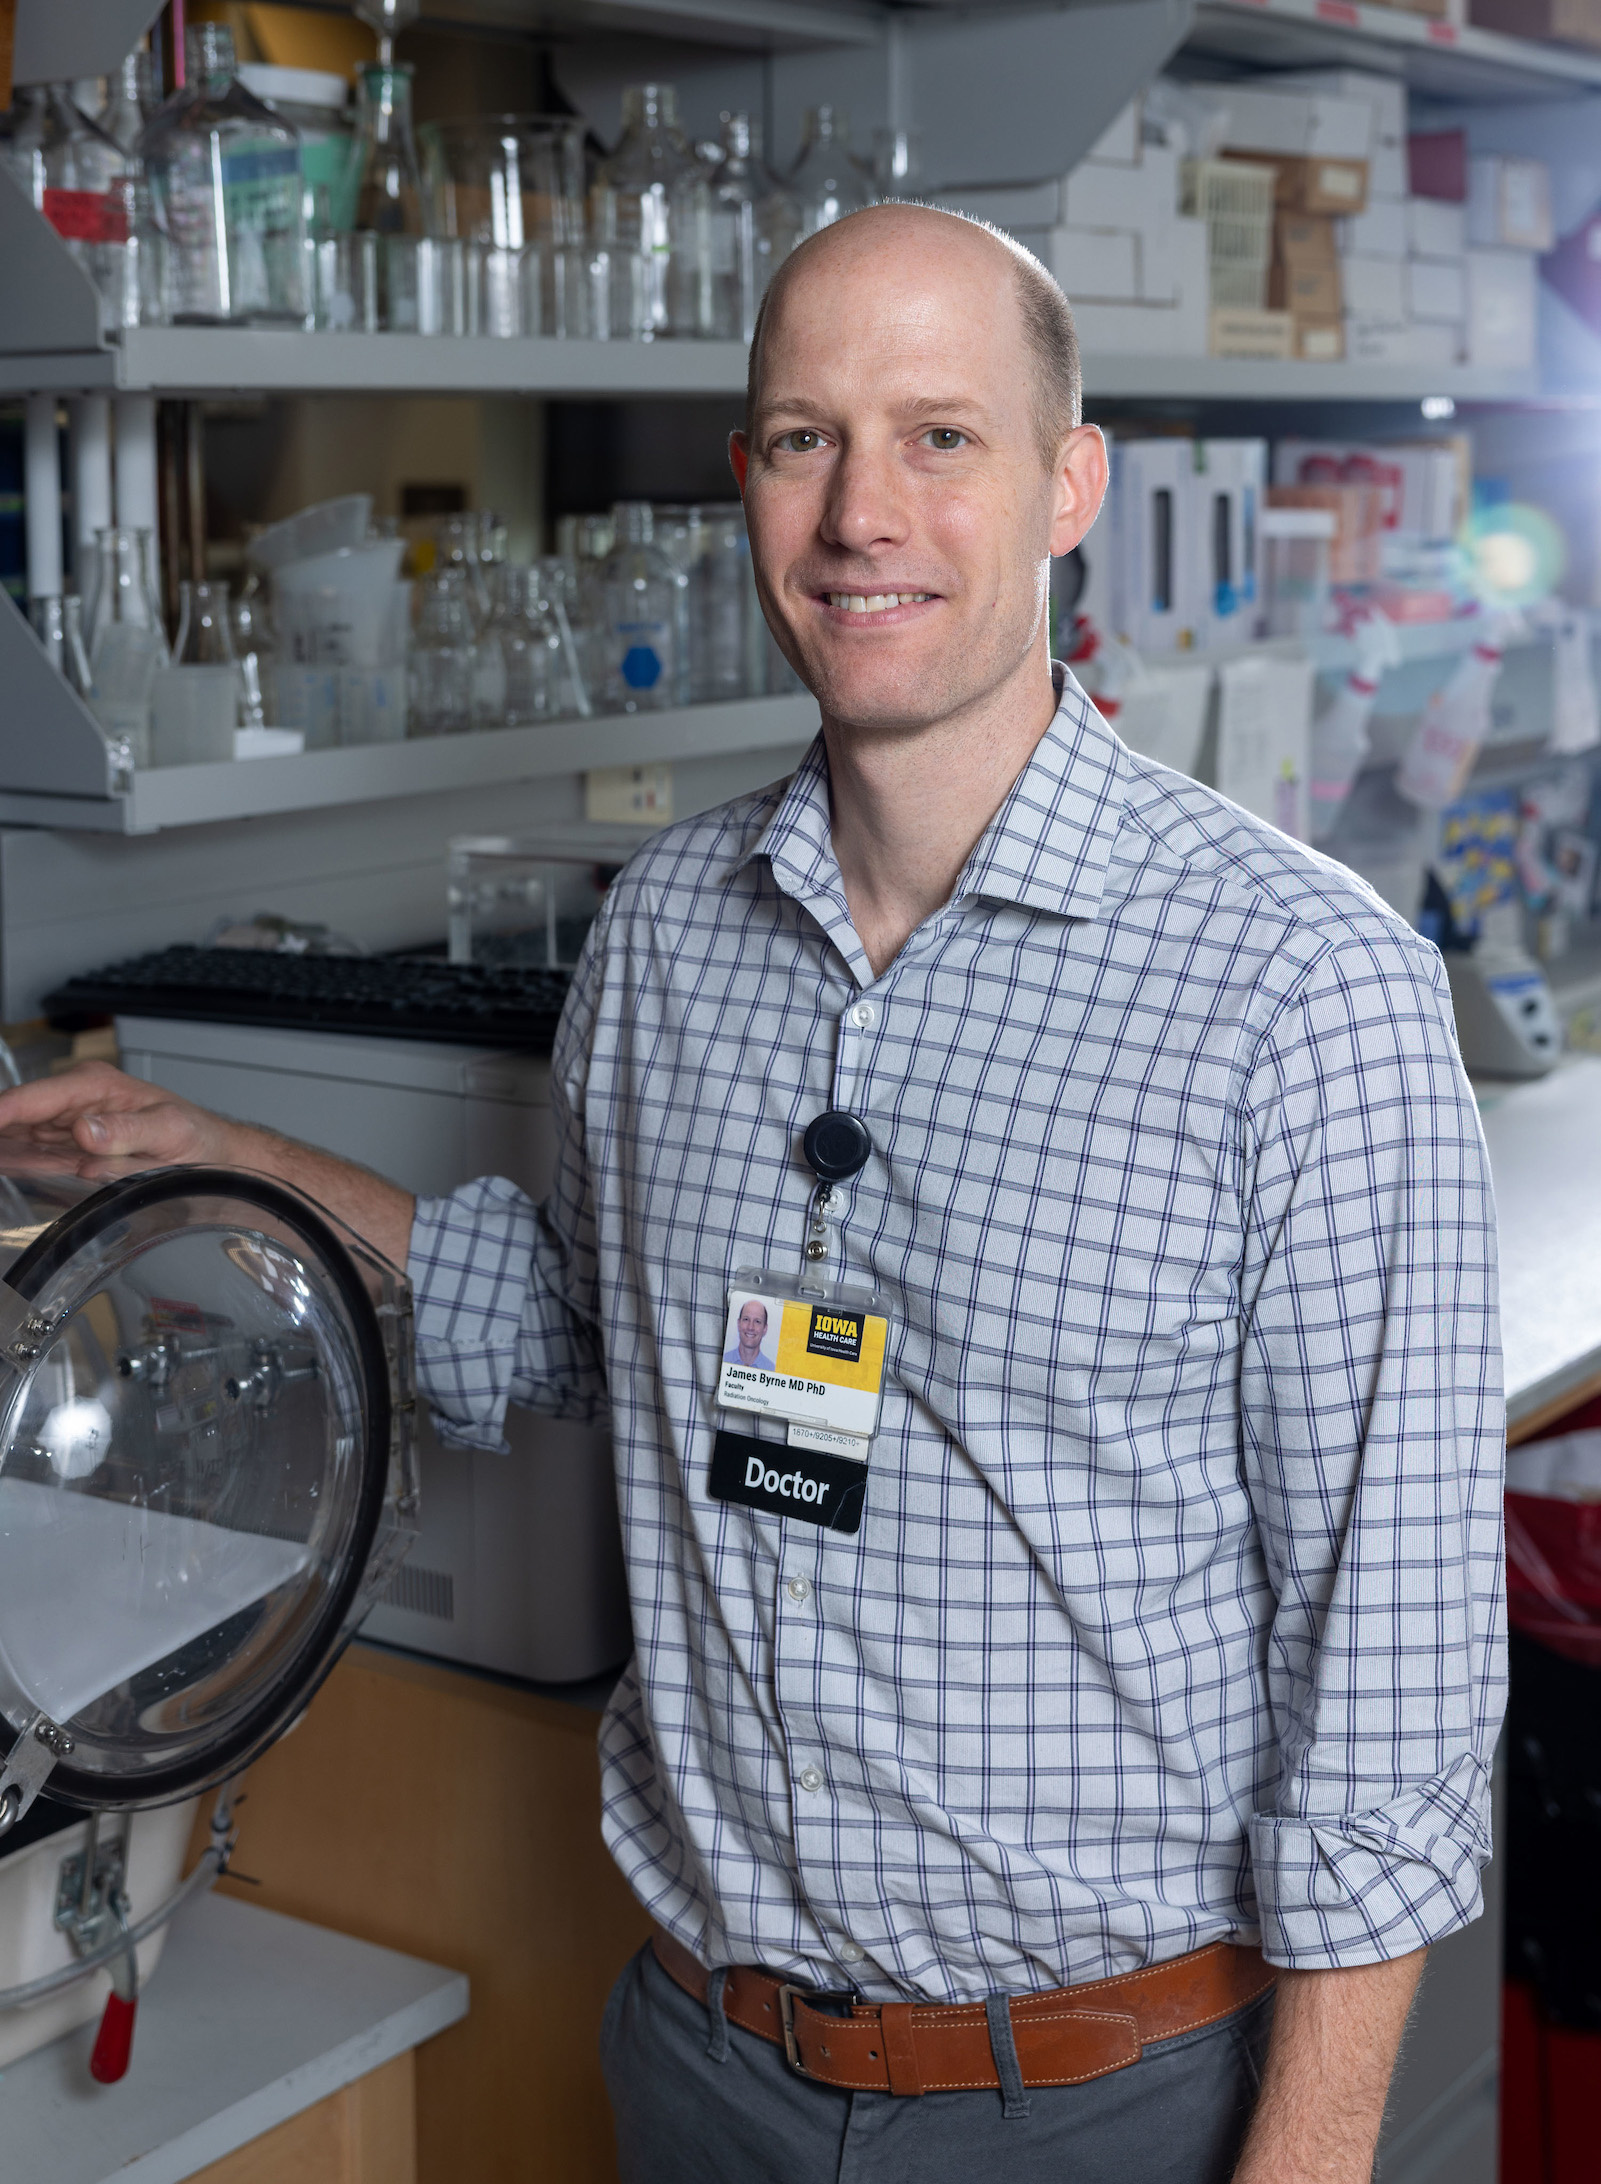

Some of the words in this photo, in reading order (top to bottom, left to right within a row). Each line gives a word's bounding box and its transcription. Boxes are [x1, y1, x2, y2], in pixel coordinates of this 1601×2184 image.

[815, 1314, 857, 1338] IOWA
[814, 1331, 838, 1342] HEALTH
[840, 1336, 857, 1346] CARE
[725, 1381, 744, 1391] Faculty
[727, 1367, 757, 1382] James
[760, 1373, 786, 1387] Byrne
[789, 1379, 804, 1391] MD
[807, 1383, 825, 1396] PhD
[724, 1391, 746, 1400] Radiation
[747, 1395, 769, 1406] Oncology
[744, 1456, 830, 1505] Doctor
